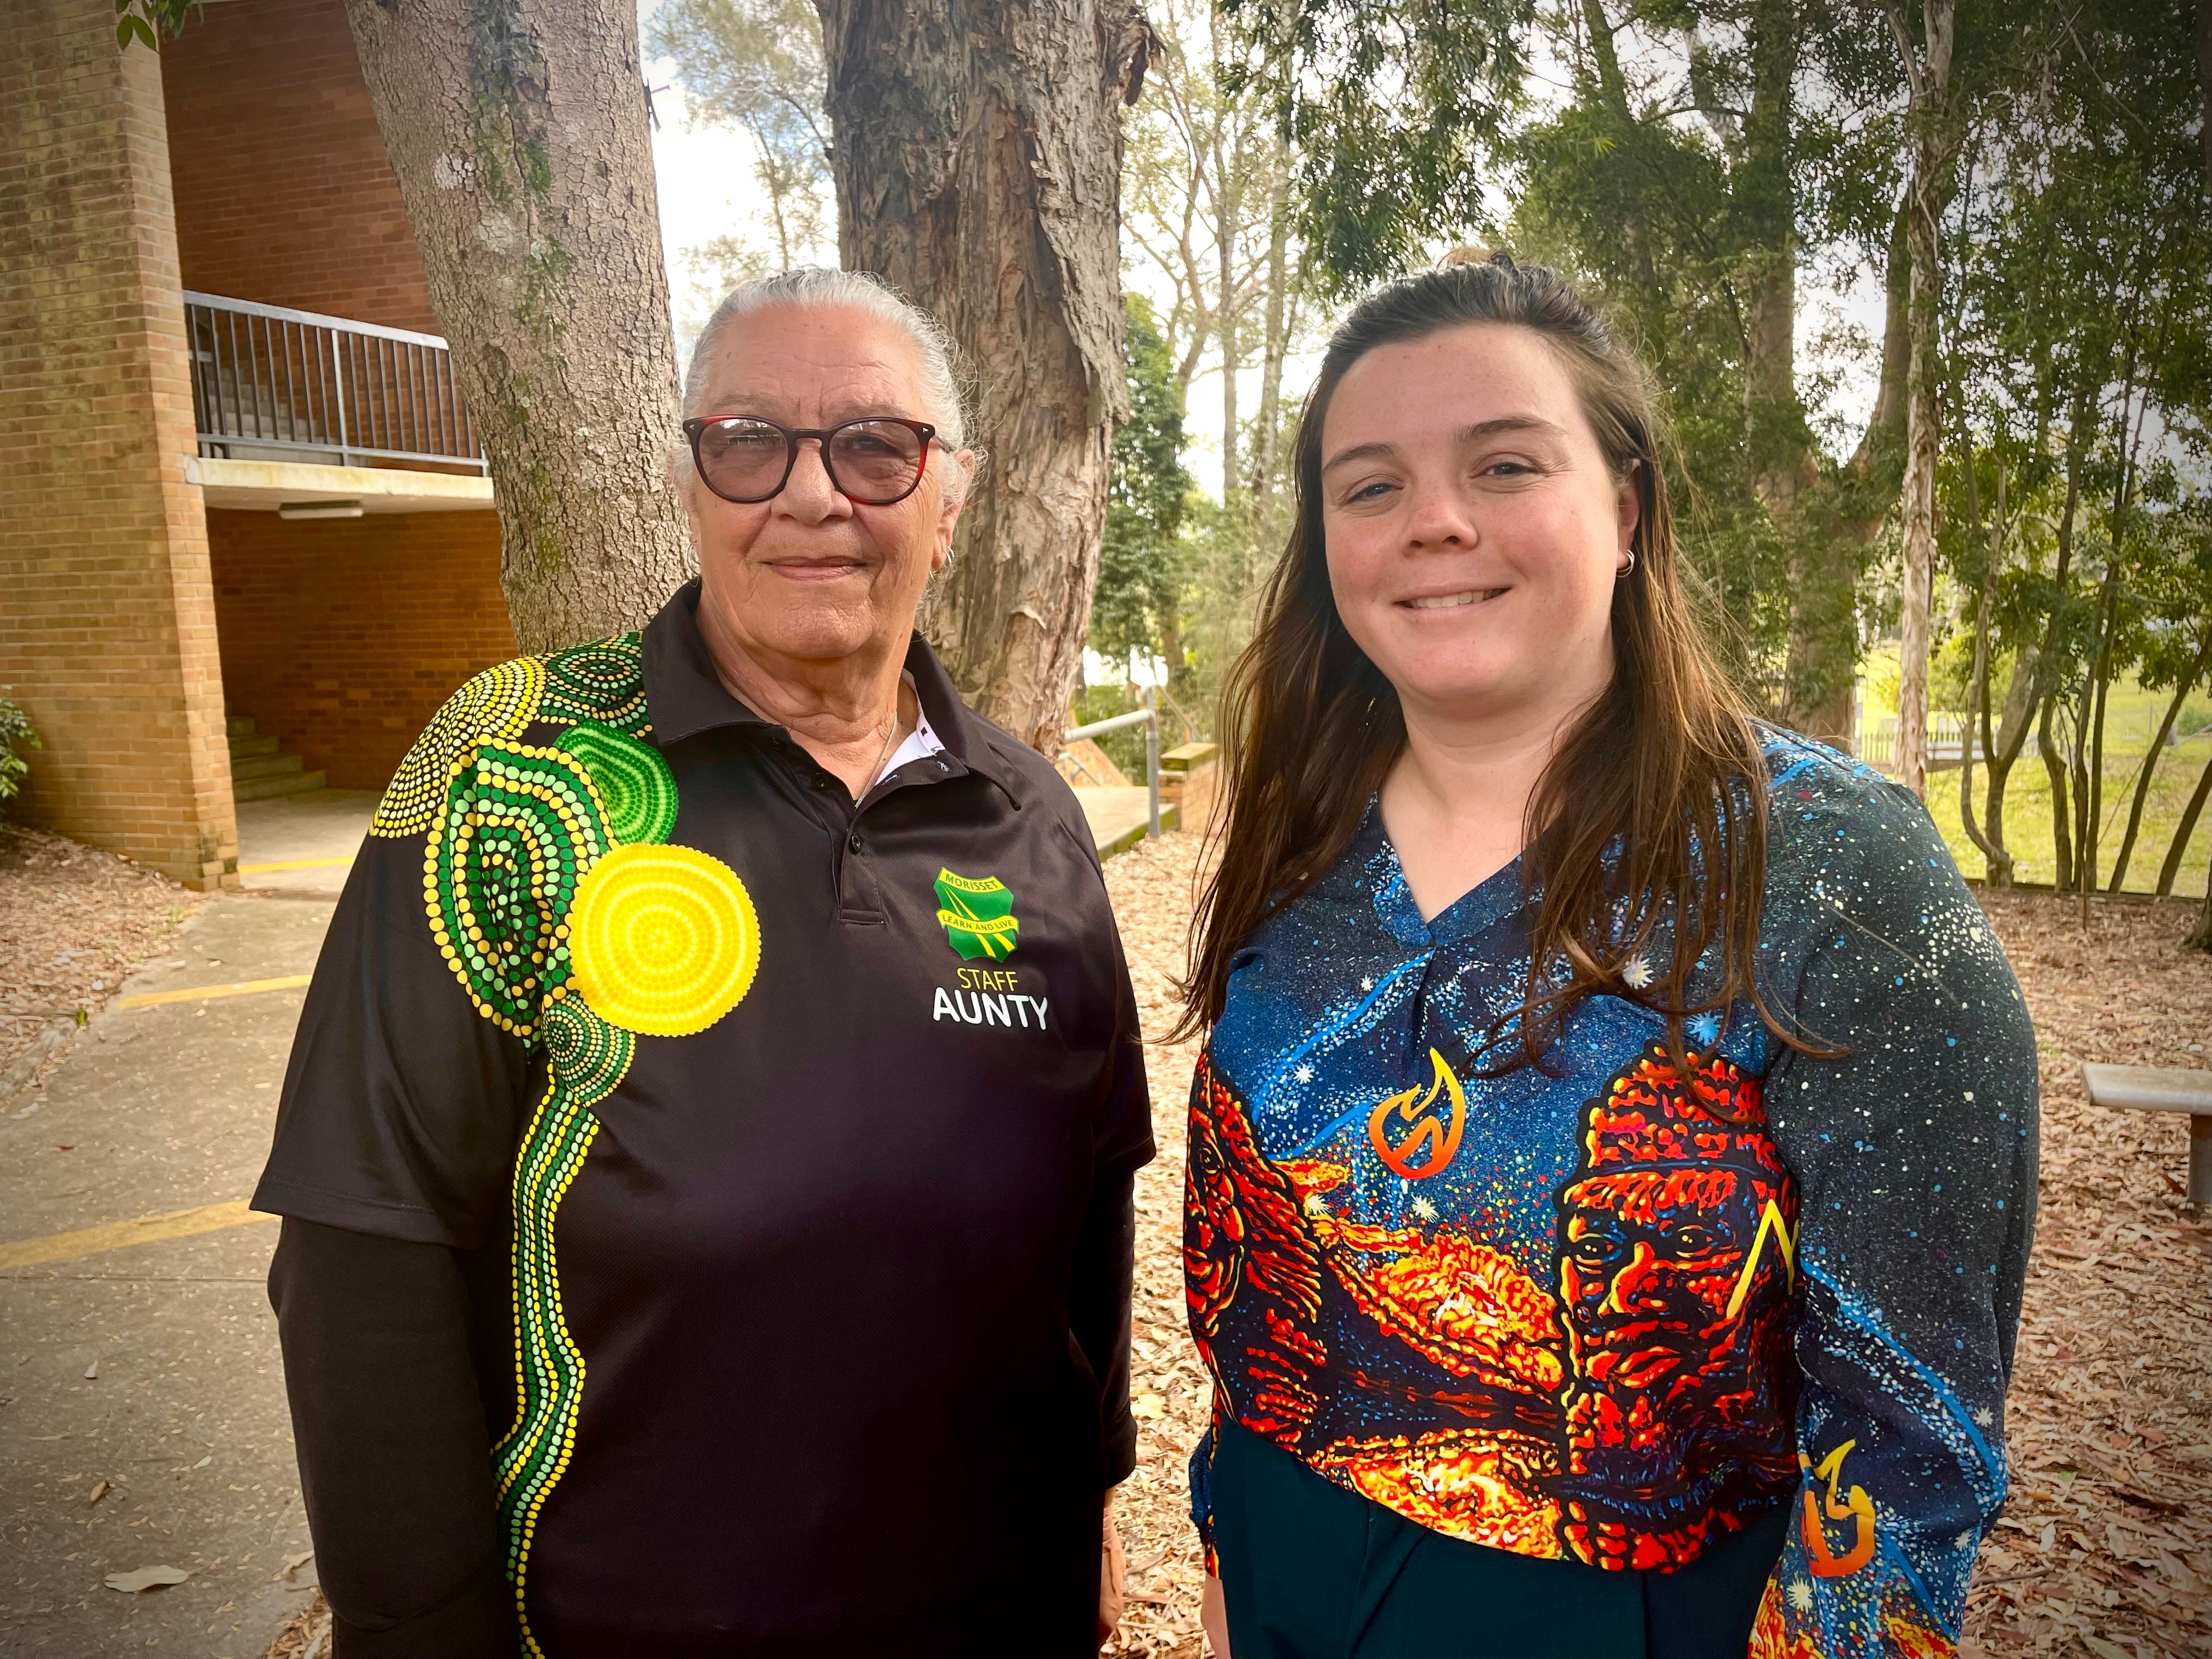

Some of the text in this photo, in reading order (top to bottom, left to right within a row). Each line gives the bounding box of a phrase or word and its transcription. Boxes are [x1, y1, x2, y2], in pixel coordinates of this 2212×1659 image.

[945, 873, 999, 891] MORISSET
[942, 914, 973, 929] LEARN
[995, 919, 1014, 929] LIVE
[957, 968, 1018, 991] STAFF
[933, 986, 1048, 1030] AUNTY
